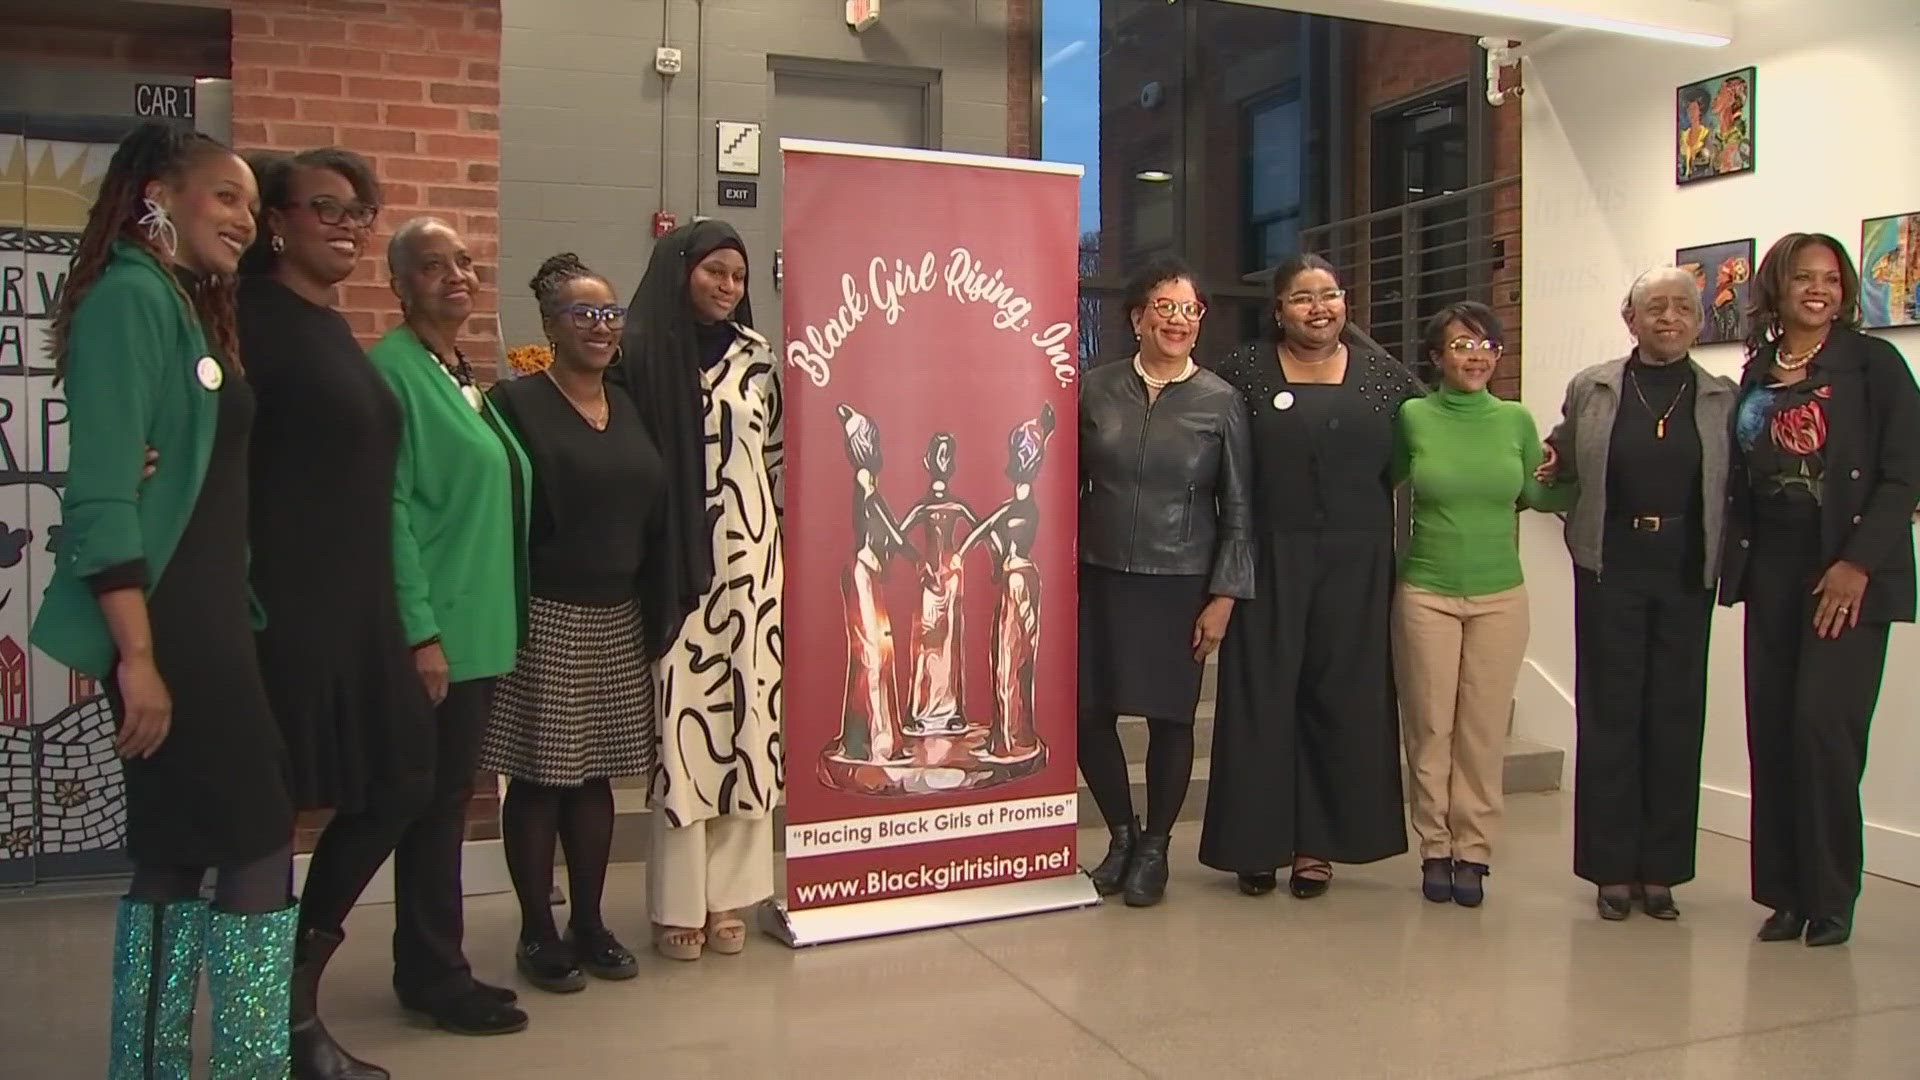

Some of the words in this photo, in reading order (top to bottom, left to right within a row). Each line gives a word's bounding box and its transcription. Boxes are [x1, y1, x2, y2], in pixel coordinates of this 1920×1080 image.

[137, 85, 177, 117] CAR
[183, 88, 193, 118] 1
[726, 188, 749, 200] EXIT
[786, 273, 868, 387] Black
[869, 252, 938, 325] Girl
[944, 247, 1032, 332] Rising,
[1031, 322, 1076, 388] Inc.
[878, 817, 929, 838] Black
[934, 813, 972, 831] Girls
[977, 810, 994, 826] at
[796, 846, 1070, 903] www.Blackgirlrising.net
